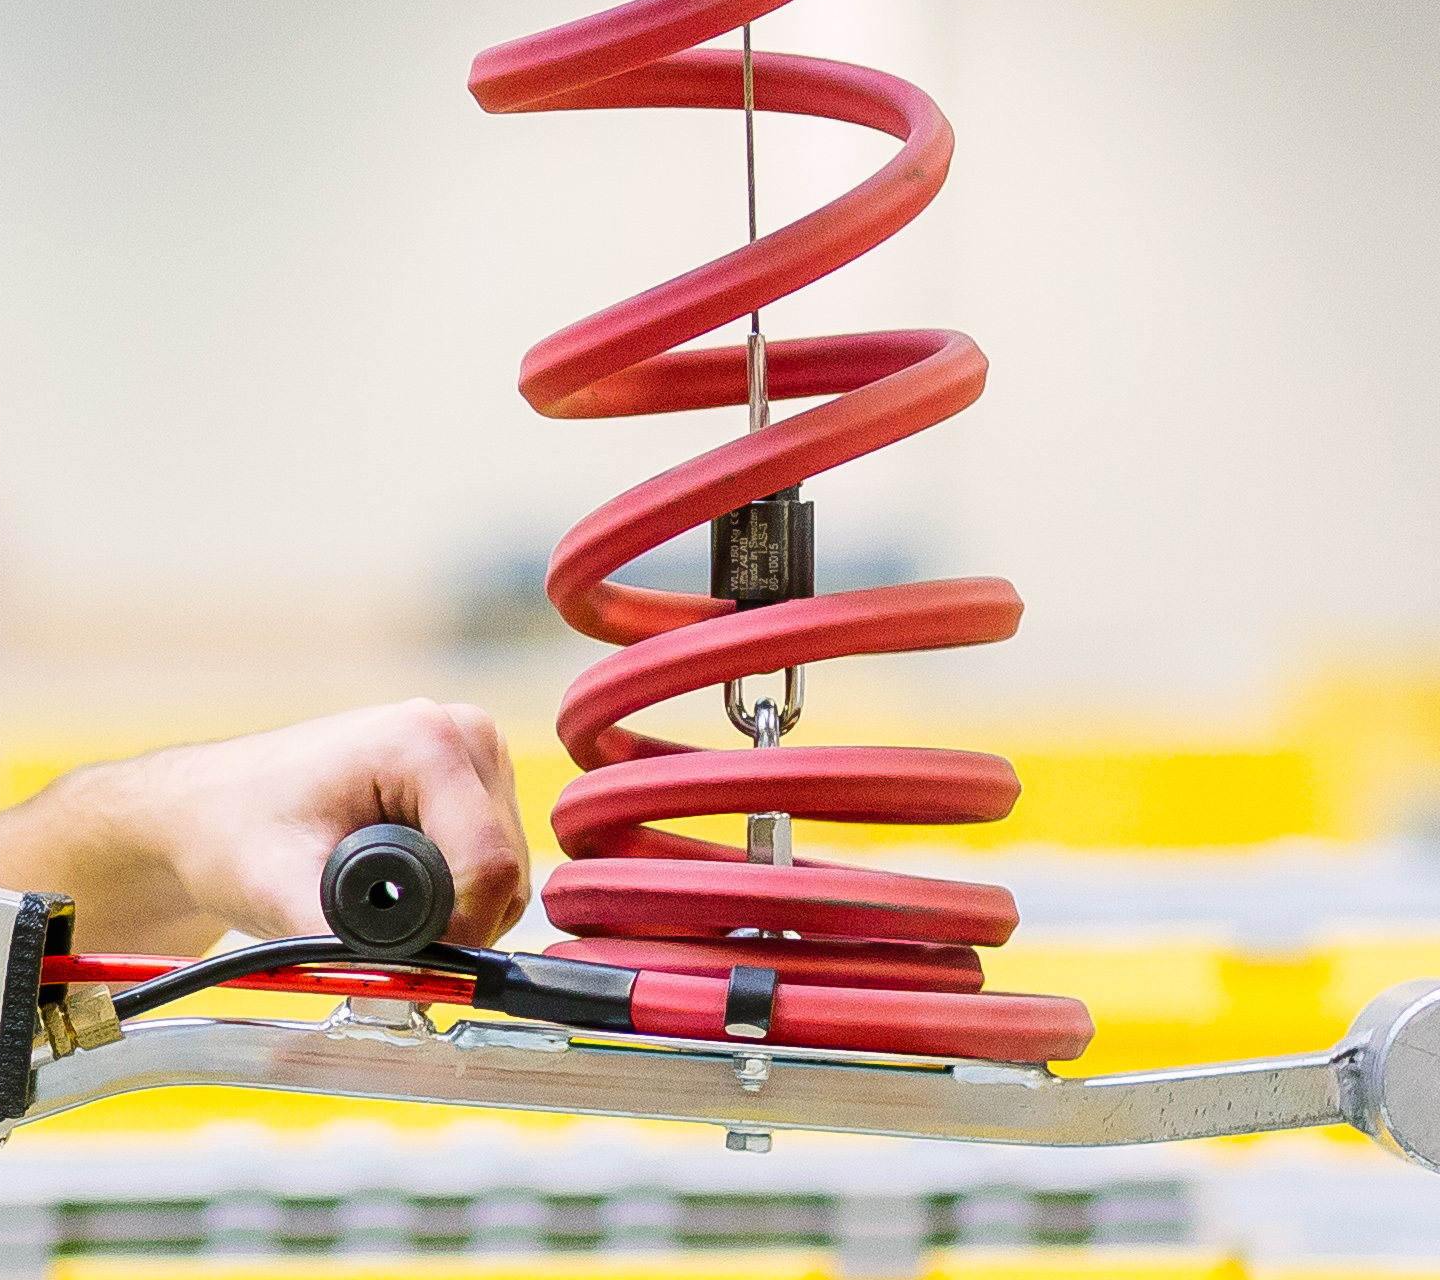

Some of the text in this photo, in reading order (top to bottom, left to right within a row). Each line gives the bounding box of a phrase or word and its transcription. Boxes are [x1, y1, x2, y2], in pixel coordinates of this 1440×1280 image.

[730, 545, 739, 564] 150
[749, 508, 759, 591] Made in Sweden
[730, 567, 740, 592] WLL
